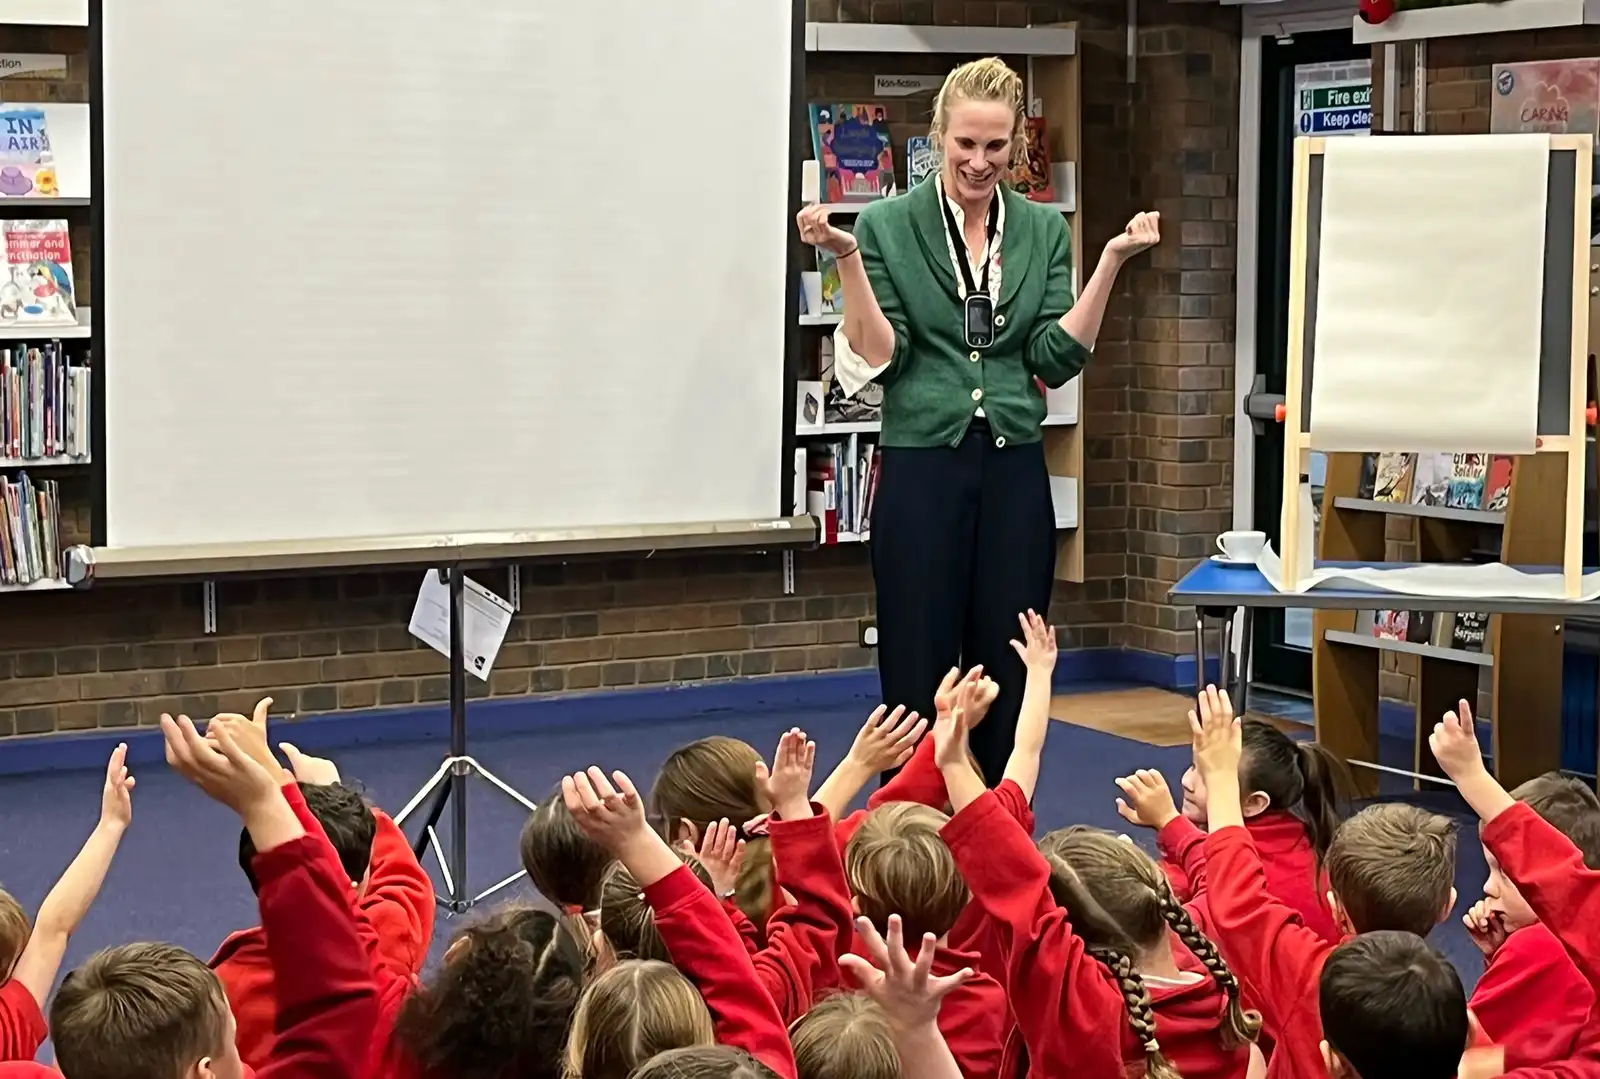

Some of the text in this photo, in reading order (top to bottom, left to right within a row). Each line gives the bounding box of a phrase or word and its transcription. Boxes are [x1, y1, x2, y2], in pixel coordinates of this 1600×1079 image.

[1327, 90, 1350, 106] Fire
[5, 117, 33, 134] IN
[1323, 113, 1350, 129] Keep
[44, 233, 65, 248] and
